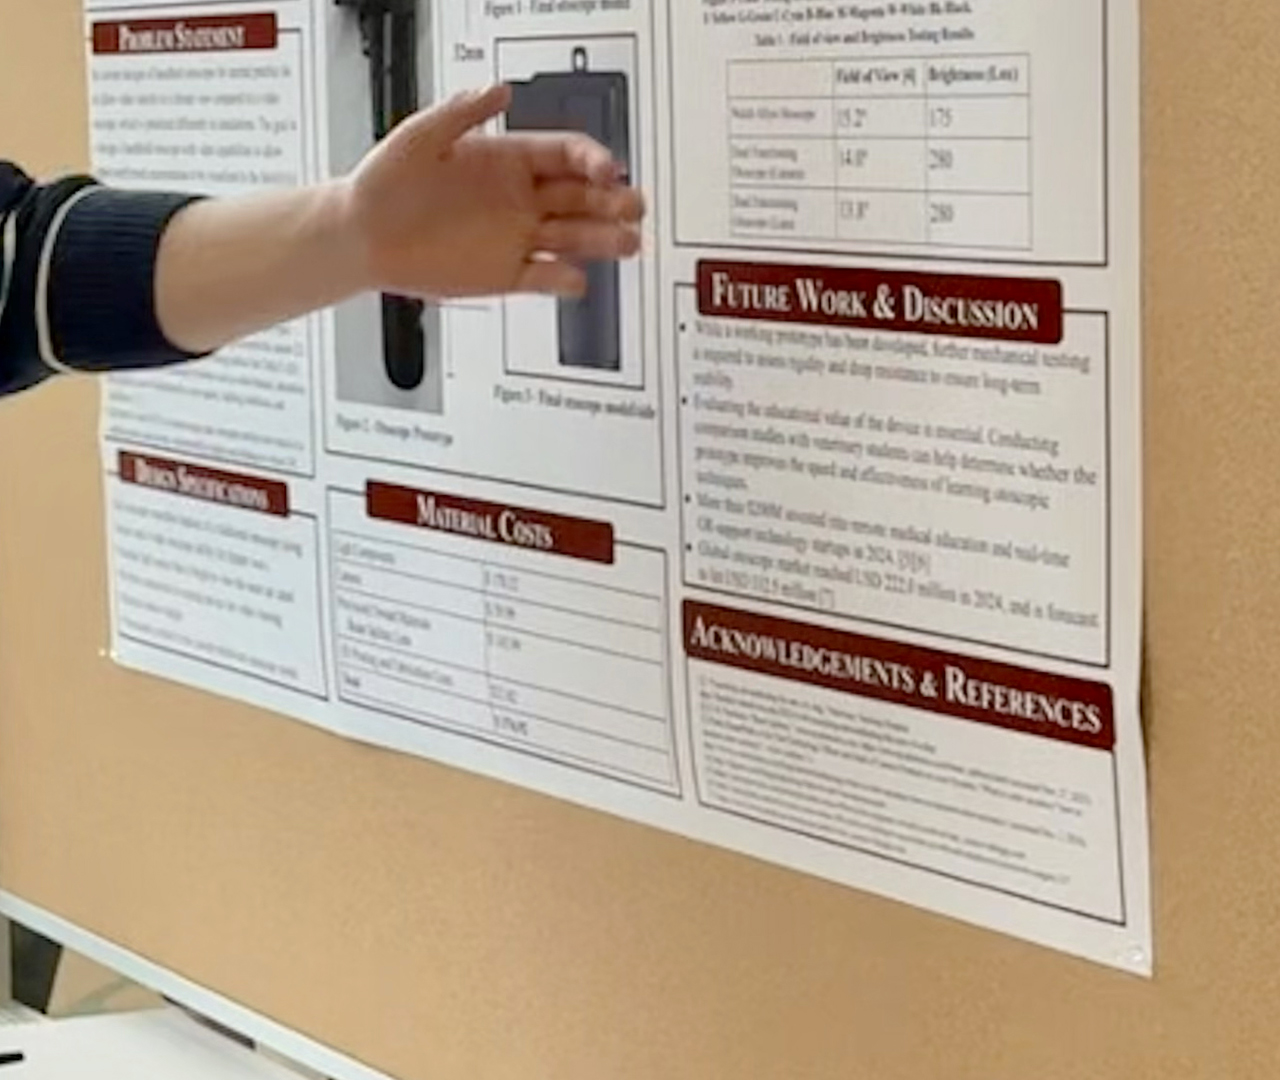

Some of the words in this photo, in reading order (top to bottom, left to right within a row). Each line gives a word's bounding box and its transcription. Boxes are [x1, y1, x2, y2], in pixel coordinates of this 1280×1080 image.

[118, 23, 175, 51] PROBLEM
[175, 21, 247, 49] STATEMENT
[930, 106, 954, 127] 175
[710, 271, 792, 312] FUTURE
[795, 277, 867, 318] WORK
[872, 283, 896, 320] &
[903, 285, 1040, 331] DISCUSSION
[416, 492, 495, 538] MATERIAL
[497, 510, 554, 551] COSTS
[690, 613, 914, 699] ACKNOWLEDGEMENTS
[919, 669, 938, 698] &
[943, 665, 1103, 735] REFERENCES
